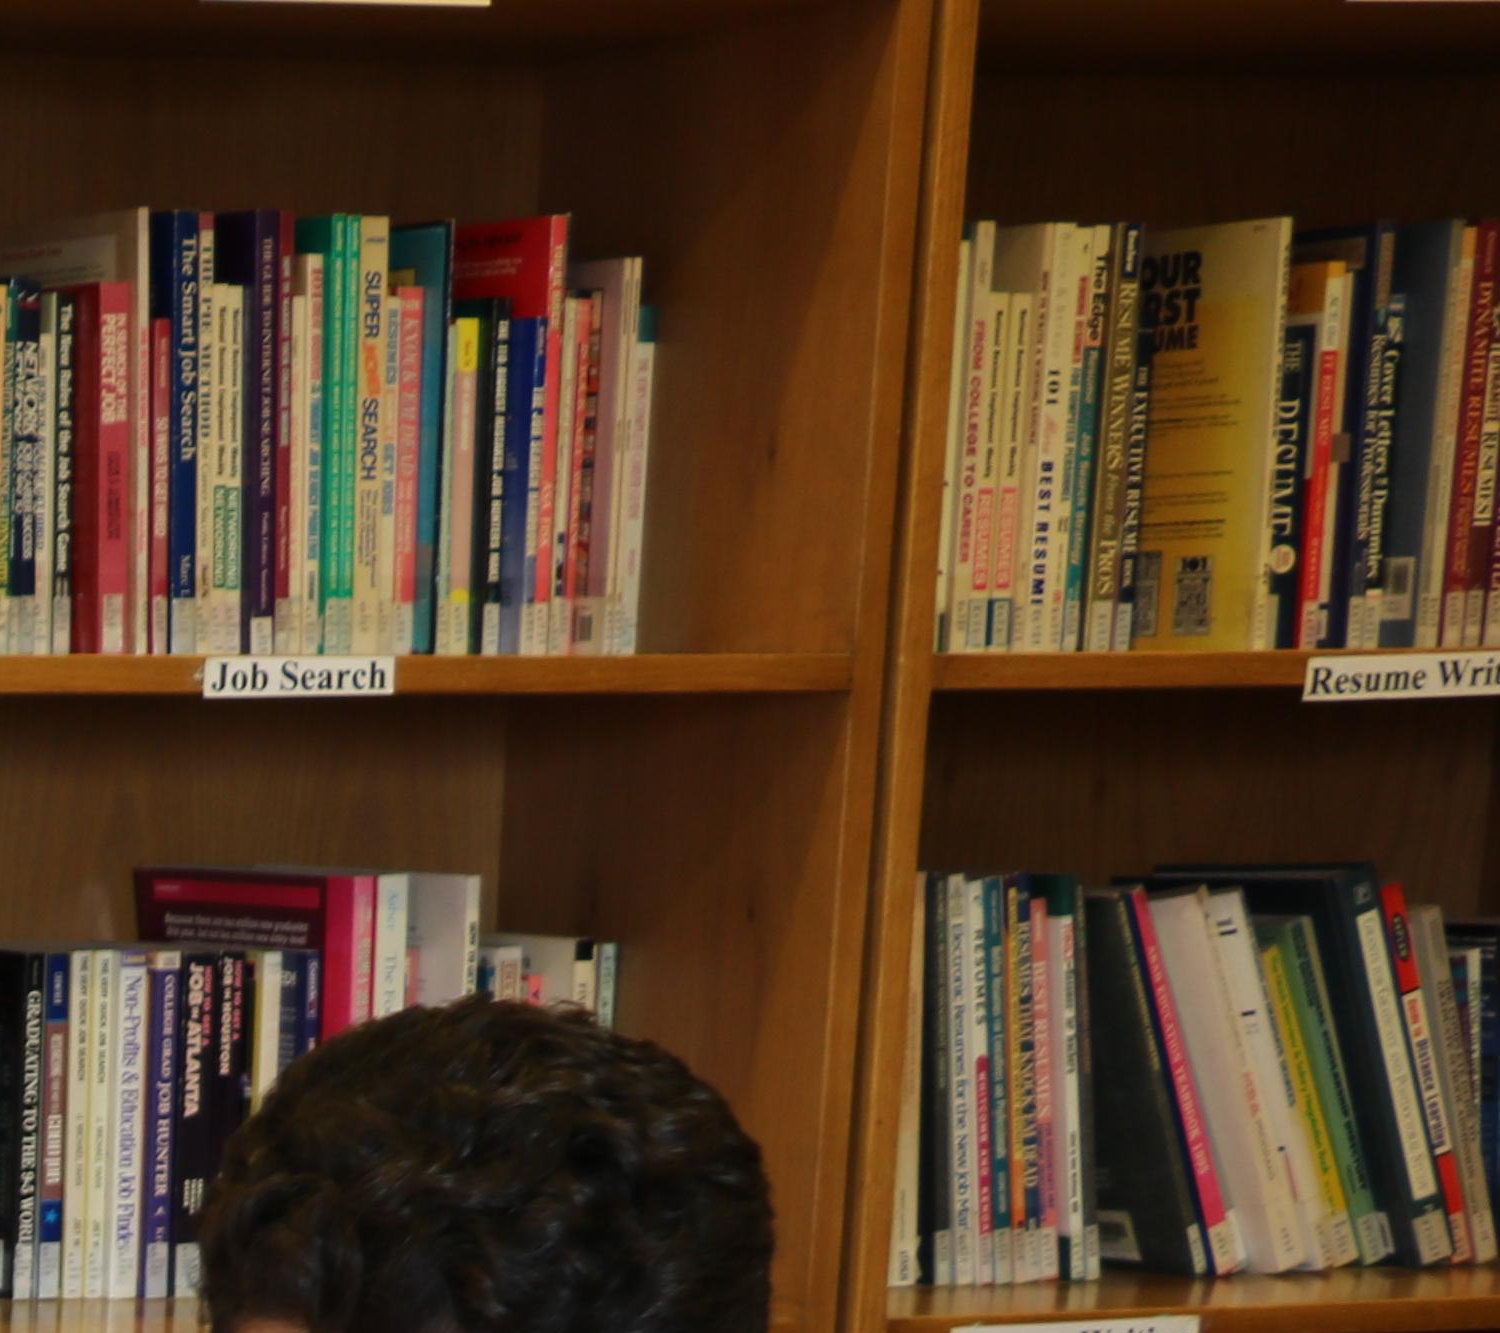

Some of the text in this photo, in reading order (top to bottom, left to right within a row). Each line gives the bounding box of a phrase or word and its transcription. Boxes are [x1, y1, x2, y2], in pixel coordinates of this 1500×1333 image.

[178, 239, 200, 460] The Smart Job Search
[214, 489, 225, 584] NETWORKING
[226, 489, 237, 587] NETWORKING
[212, 660, 386, 691] Job Search
[1309, 666, 1426, 695] Resume
